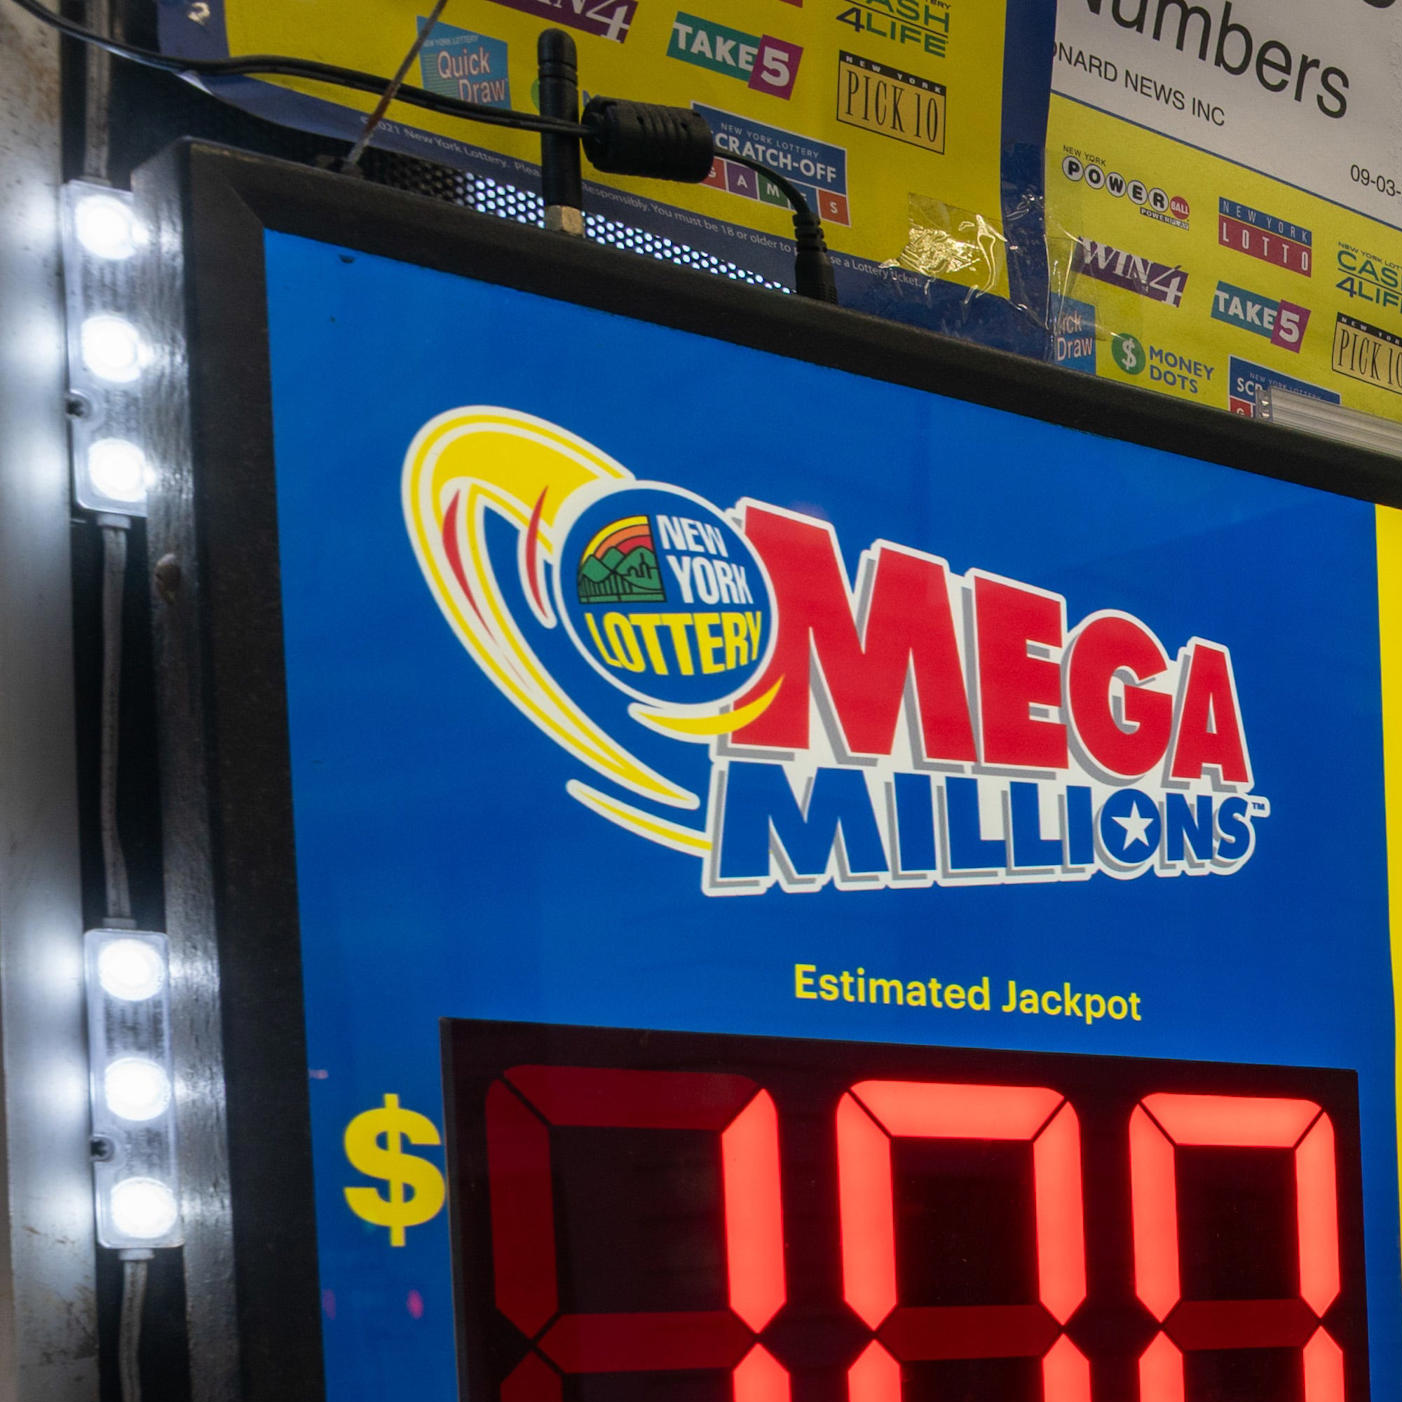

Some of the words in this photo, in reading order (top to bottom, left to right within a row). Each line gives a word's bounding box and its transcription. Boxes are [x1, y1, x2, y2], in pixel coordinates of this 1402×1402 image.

[836, 6, 947, 58] 4LIFE
[437, 47, 490, 79] Quick
[846, 56, 881, 73] NEW
[897, 73, 941, 93] YORK
[1086, 0, 1350, 120] umbers
[457, 79, 506, 104] Draw
[845, 70, 904, 133] PICK
[914, 93, 938, 142] 10
[1124, 69, 1185, 111] NEWS
[1191, 97, 1226, 127] INC
[710, 130, 837, 184] CRATCH-OFF
[720, 122, 743, 136] NEW
[747, 131, 773, 145] YORK
[776, 140, 820, 160] LOTTERY
[1222, 200, 1257, 224] NEW
[1267, 214, 1309, 243] YORK
[1222, 222, 1309, 272] LOTTO
[1056, 336, 1094, 362] Draw
[1149, 345, 1215, 381] MONEY
[1338, 329, 1383, 381] PICK
[1149, 366, 1199, 394] DOTS
[657, 512, 727, 558] NEW
[665, 554, 754, 607] YORK
[582, 609, 764, 679] LOTTERY
[731, 503, 1251, 787] MEGA
[793, 962, 993, 1013] Estimated
[1002, 977, 1143, 1024] Jackpot
[342, 1093, 447, 1247] $
